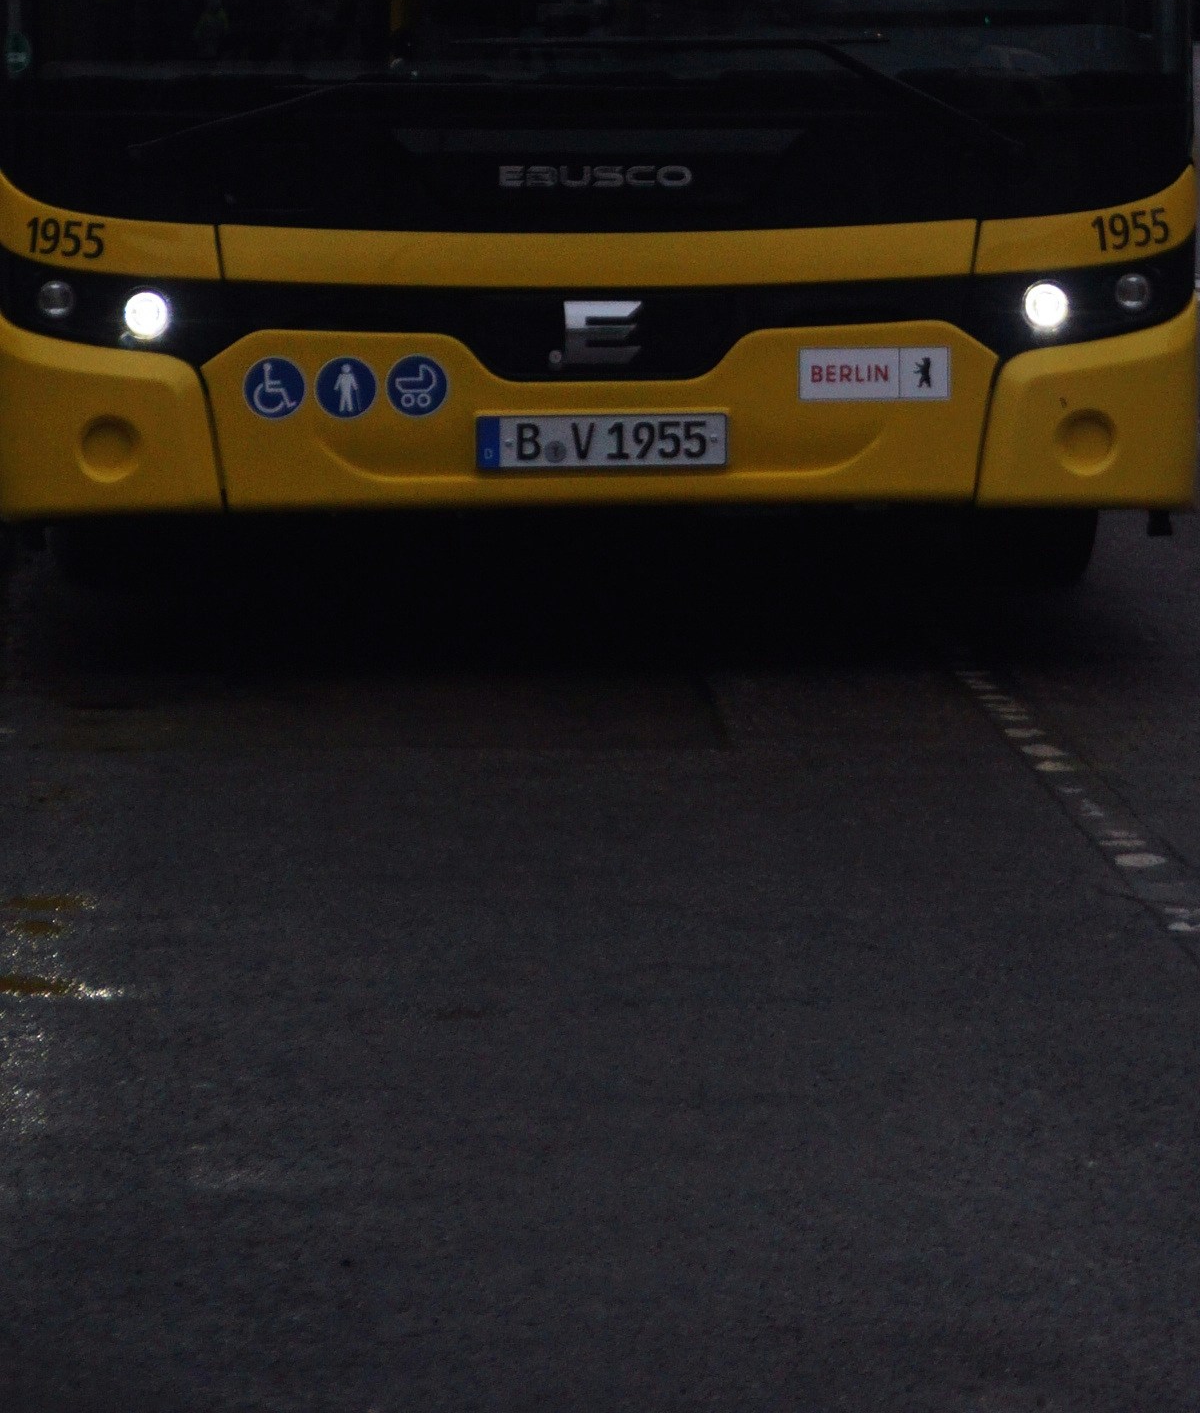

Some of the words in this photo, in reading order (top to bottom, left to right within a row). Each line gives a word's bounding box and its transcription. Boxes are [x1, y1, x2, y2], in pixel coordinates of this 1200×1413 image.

[499, 165, 692, 188] EBUSCO
[27, 217, 105, 259] 1955
[1091, 207, 1169, 252] 1955
[811, 365, 889, 383] BERLIN
[516, 423, 541, 461] B
[572, 422, 595, 460] V
[607, 421, 707, 459] 1955
